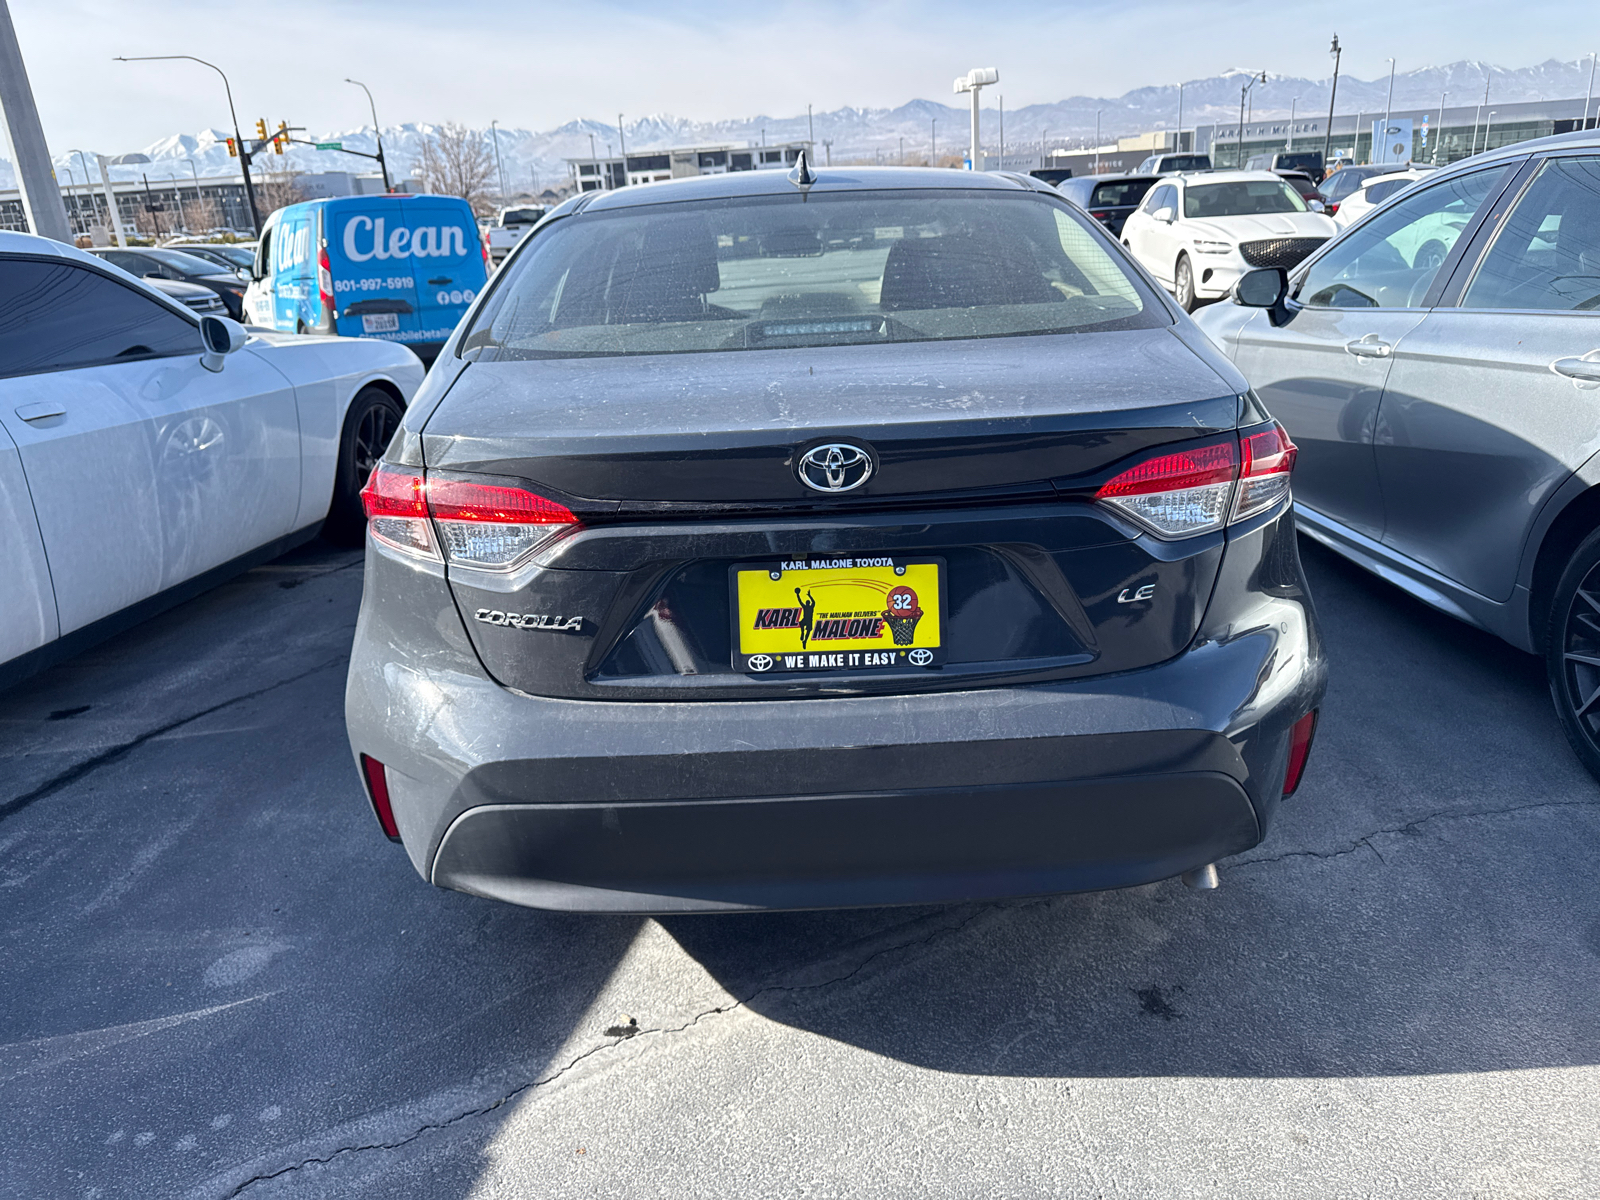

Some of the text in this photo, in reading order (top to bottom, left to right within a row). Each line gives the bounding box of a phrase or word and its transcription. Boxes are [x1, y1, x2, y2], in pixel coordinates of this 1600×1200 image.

[1271, 123, 1318, 135] MILER
[343, 215, 468, 262] Clean
[334, 277, 415, 292] 801-997-5919
[781, 558, 893, 570] KARL MALONE TOYOTA
[893, 594, 912, 609] 32
[1117, 583, 1156, 604] LE
[474, 608, 583, 631] COROLLA
[753, 608, 802, 630] KARL
[811, 618, 885, 641] MALONE
[784, 652, 896, 668] WE MAKE IT EASY
